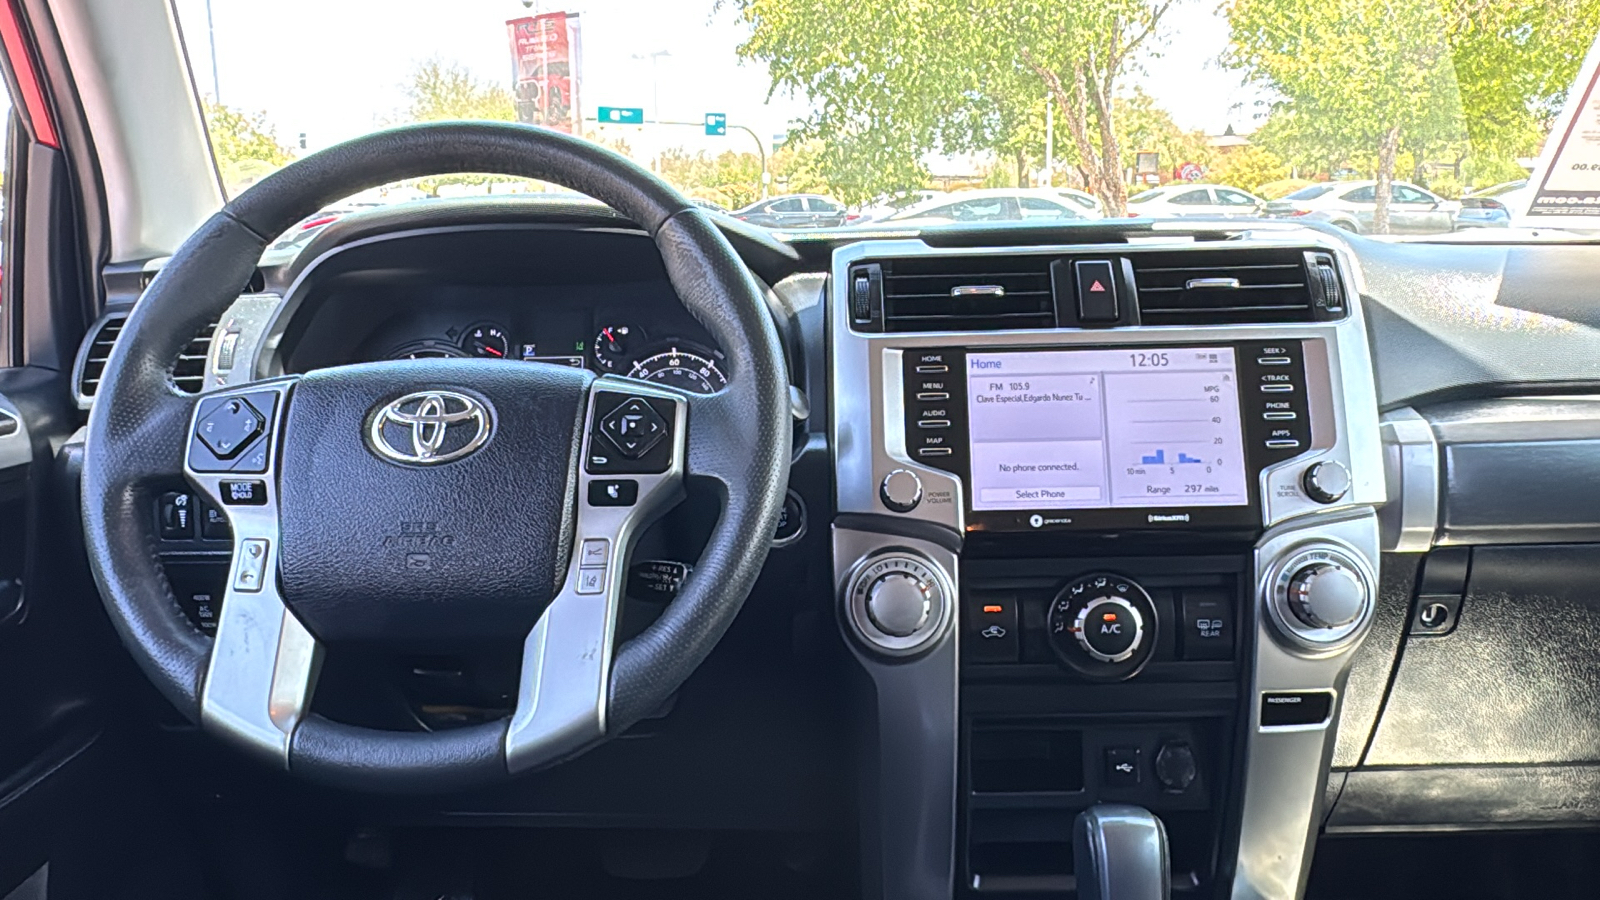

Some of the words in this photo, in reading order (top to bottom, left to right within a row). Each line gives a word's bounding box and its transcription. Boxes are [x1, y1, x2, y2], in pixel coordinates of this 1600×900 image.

[669, 358, 680, 366] 60
[971, 359, 1002, 369] Home
[1130, 353, 1169, 367] 12:05
[640, 368, 649, 378] 40
[989, 383, 1003, 391] FM
[1009, 382, 1030, 391] 105.9
[976, 394, 995, 403] Clave
[1052, 393, 1074, 402] Nunez
[1212, 416, 1222, 424] 40
[1214, 437, 1223, 445] 20
[999, 464, 1011, 472] No
[1013, 464, 1036, 473] phone
[1038, 463, 1080, 472] connected.
[230, 482, 253, 491] MODE
[1147, 485, 1171, 495] Range
[1184, 485, 1202, 493] 297
[1204, 485, 1219, 493] miles
[1016, 489, 1040, 499] Select
[1041, 489, 1066, 499] Phone
[1101, 624, 1121, 633] A/C
